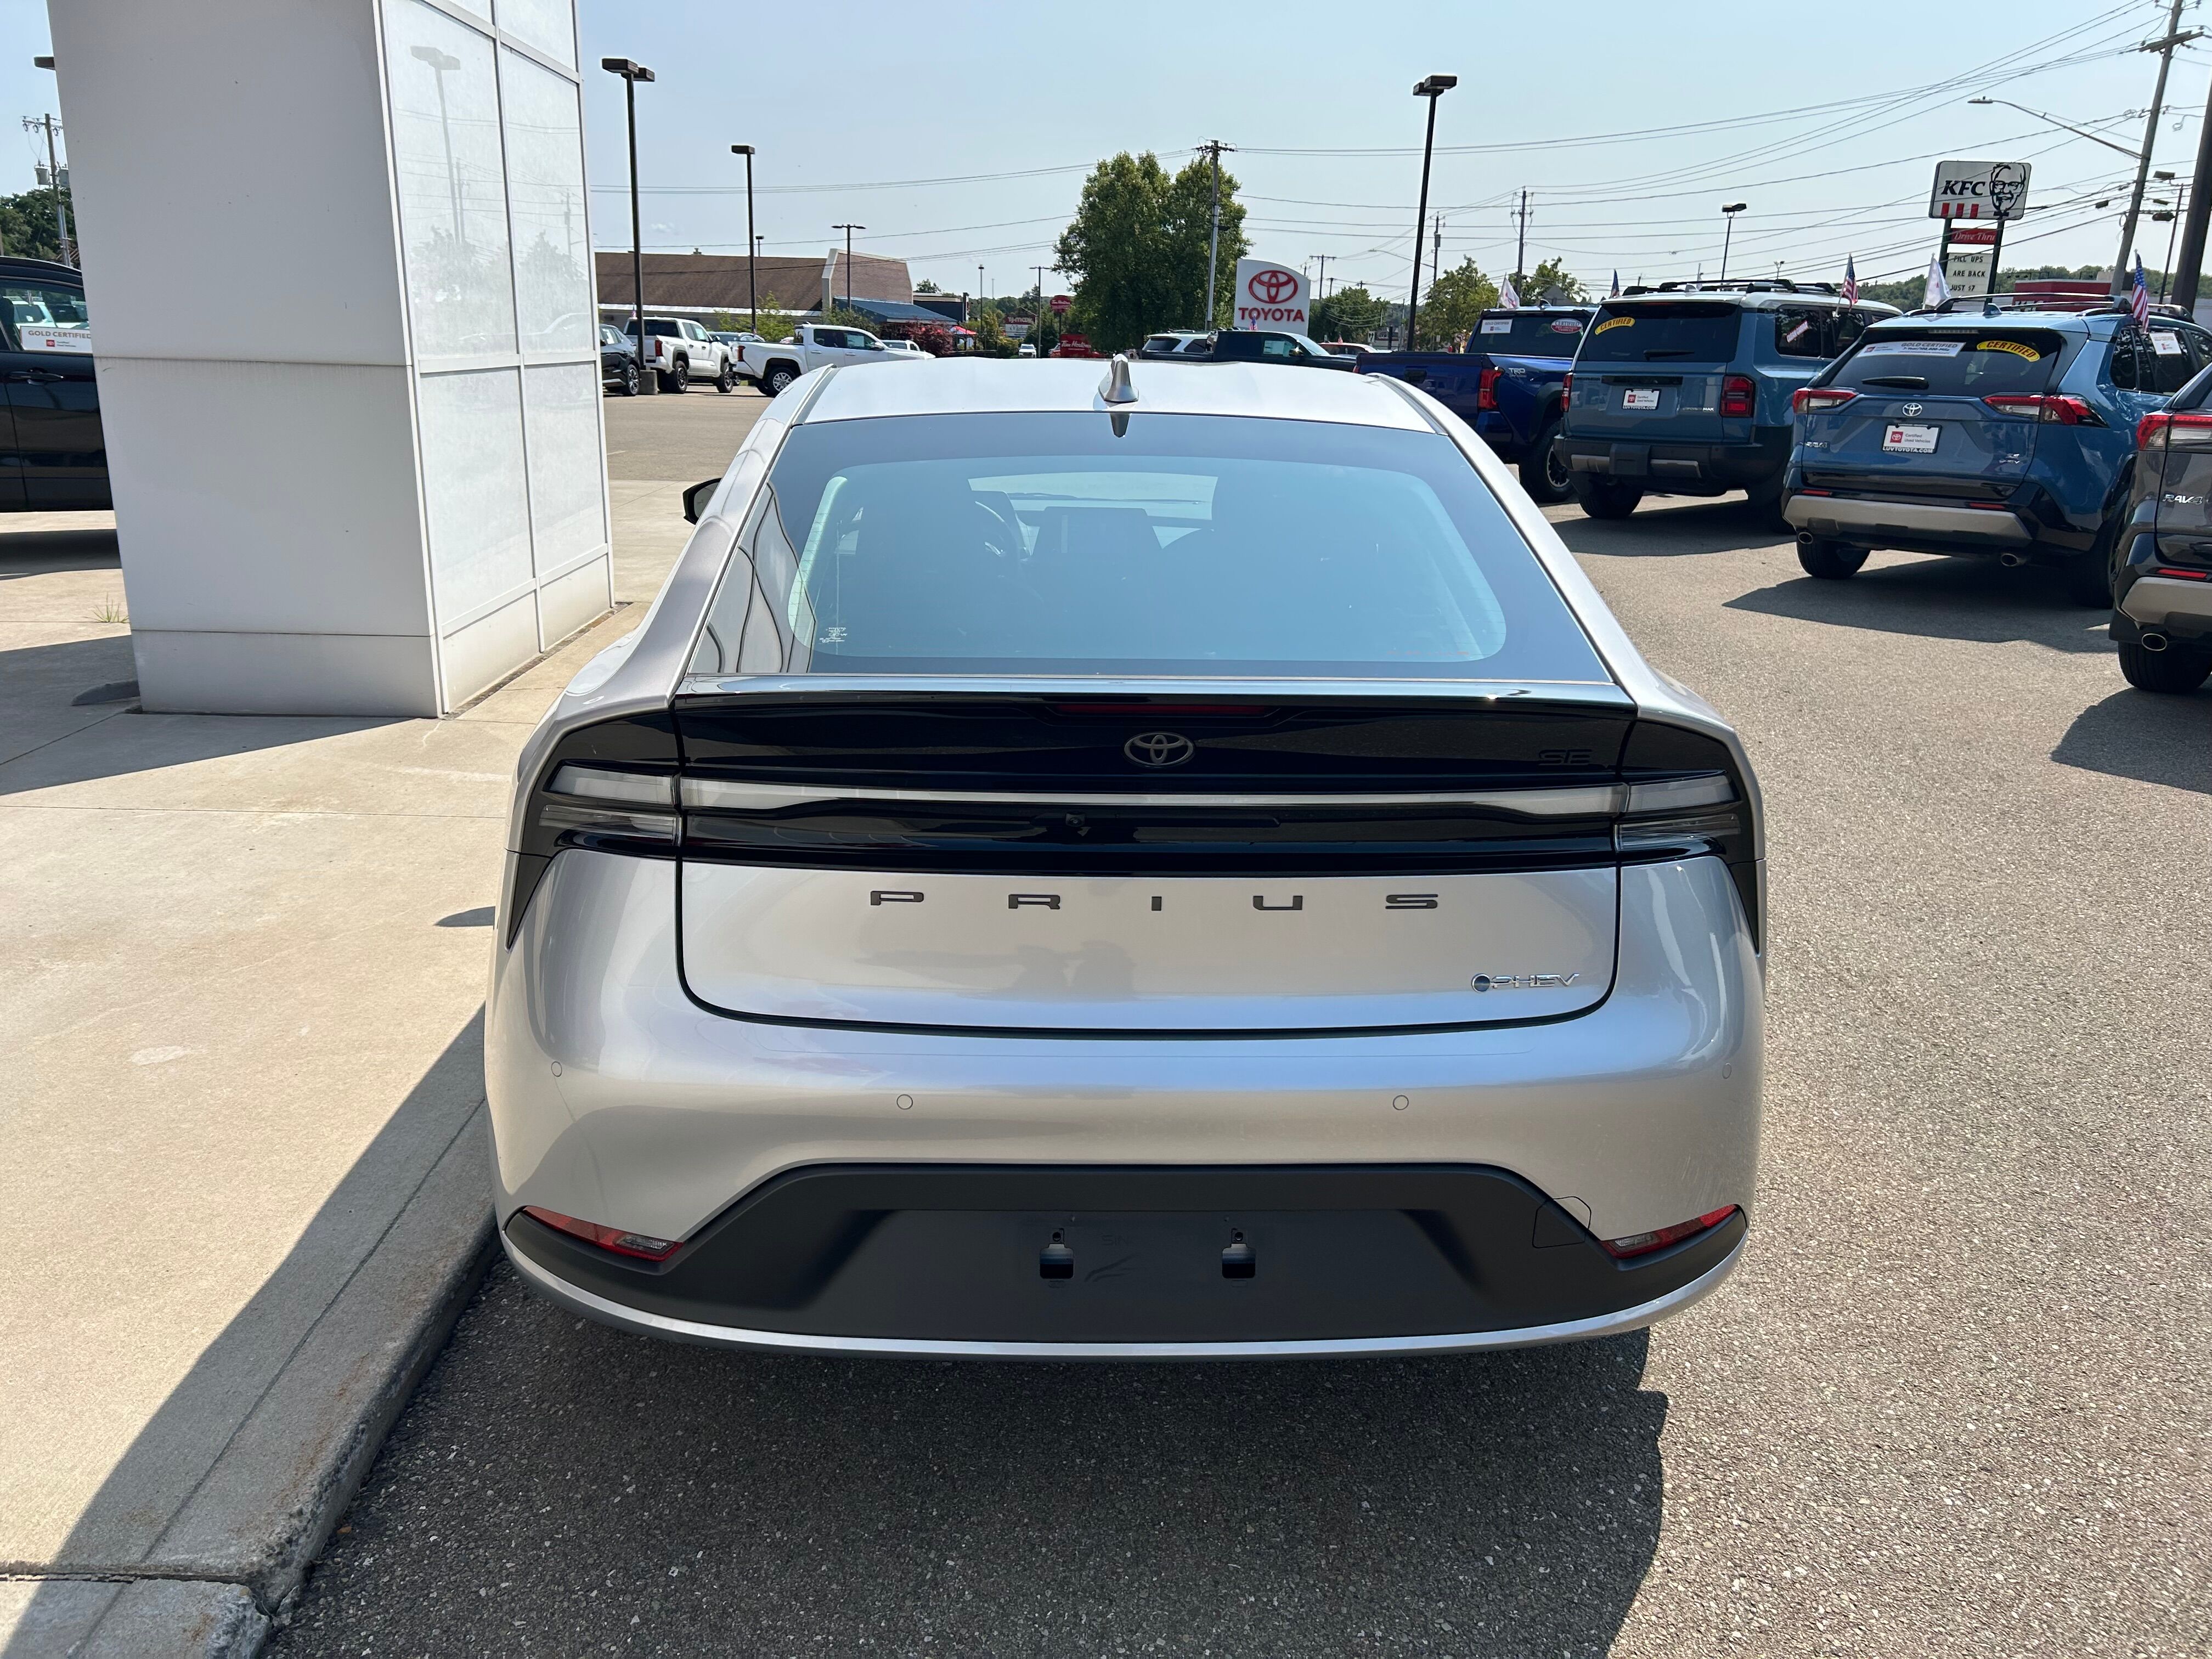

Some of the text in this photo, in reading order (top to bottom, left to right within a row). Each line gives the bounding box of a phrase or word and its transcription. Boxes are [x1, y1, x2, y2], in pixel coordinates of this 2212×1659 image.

[1941, 180, 1985, 196] KFC
[1954, 231, 1996, 241] Drive Thru
[1238, 307, 1305, 321] TOYOTA
[1600, 319, 1632, 330] CERTIFIED
[1987, 341, 2036, 358] CERTIFIED
[2162, 494, 2203, 505] RAV4
[1539, 749, 1592, 766] SE
[870, 889, 1438, 911] PRIUS
[1491, 973, 1580, 988] PHEV
